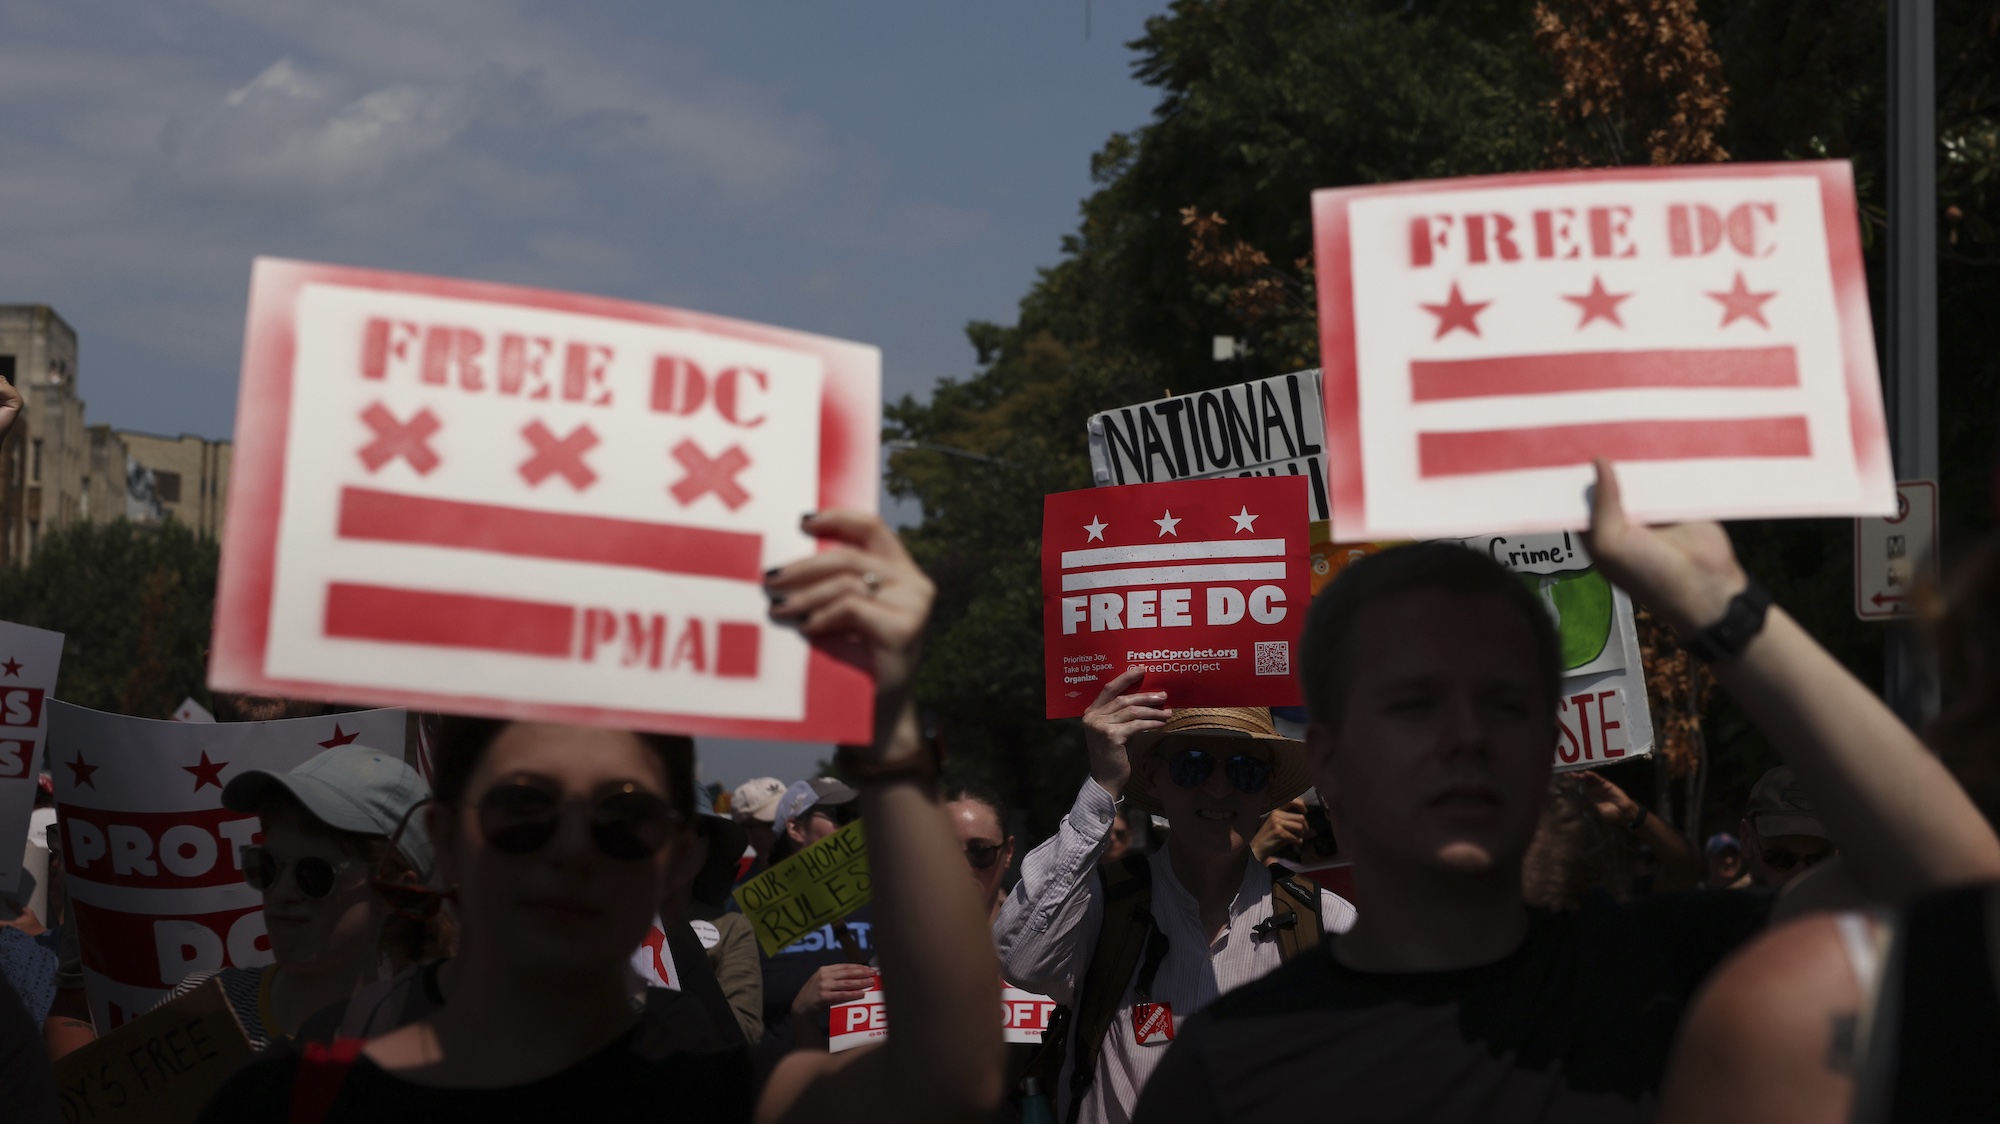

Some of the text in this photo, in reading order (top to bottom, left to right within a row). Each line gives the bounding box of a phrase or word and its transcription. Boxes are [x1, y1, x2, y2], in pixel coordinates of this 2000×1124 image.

[1407, 202, 1778, 268] FREE DC
[360, 316, 770, 429] FREE DC
[1102, 375, 1321, 486] NATIONAL
[1489, 530, 1574, 567] Crime!
[578, 606, 712, 675] PMA
[1062, 585, 1288, 635] FREE DC
[1063, 653, 1107, 664] Prioritize Joy.
[1063, 662, 1114, 674] Take Up Space.
[1064, 673, 1098, 684] Organize.
[1127, 647, 1238, 661] FreeDCproject.org
[1552, 691, 1625, 764] STE
[67, 815, 264, 878] PROT
[742, 870, 789, 911] OUR
[798, 828, 869, 879] HOME
[761, 862, 872, 942] RULES
[846, 1004, 888, 1032] PE
[129, 1018, 218, 1091] FREE
